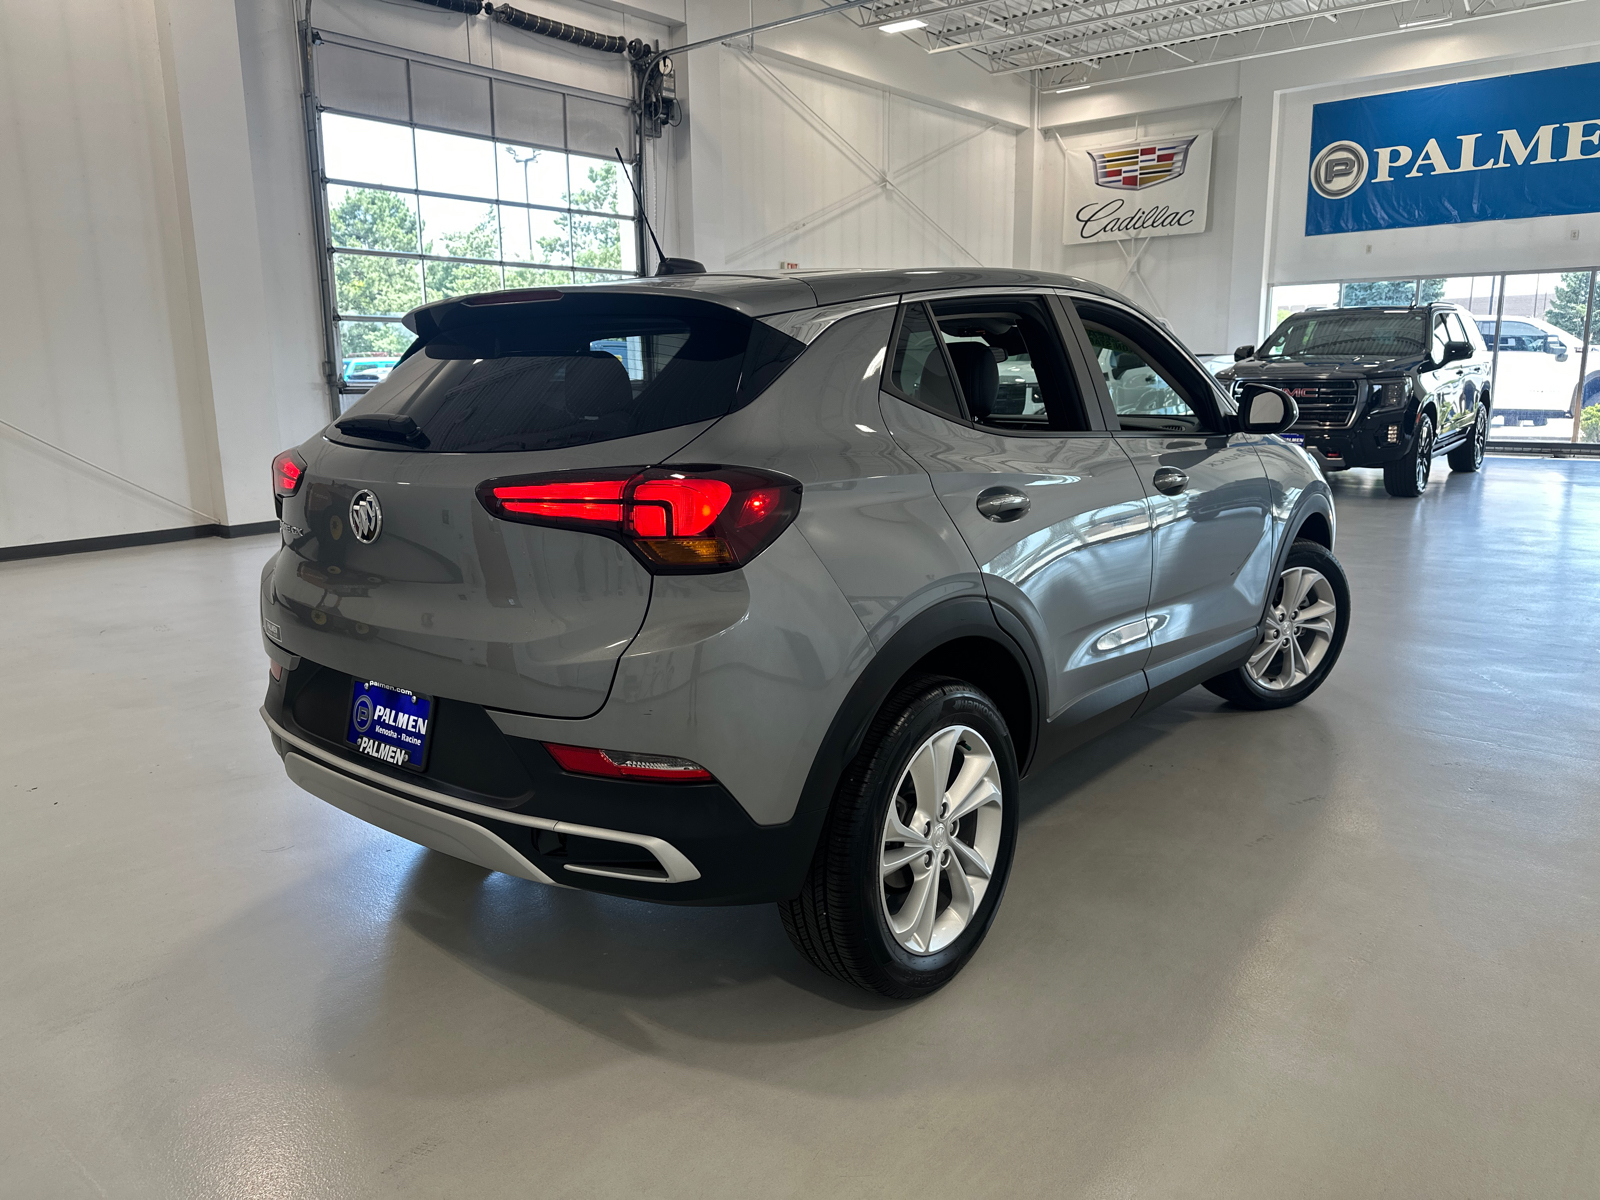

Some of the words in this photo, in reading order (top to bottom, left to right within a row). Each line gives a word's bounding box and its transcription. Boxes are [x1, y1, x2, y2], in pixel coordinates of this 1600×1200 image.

[1371, 118, 1600, 183] PALME
[1076, 198, 1195, 239] Cadillac
[1281, 387, 1319, 398] MC
[369, 680, 413, 696] palmen.com
[374, 705, 428, 735] PALMEN
[375, 725, 397, 739] Kenosha
[401, 733, 421, 746] Racine
[360, 736, 405, 766] PALMEN
